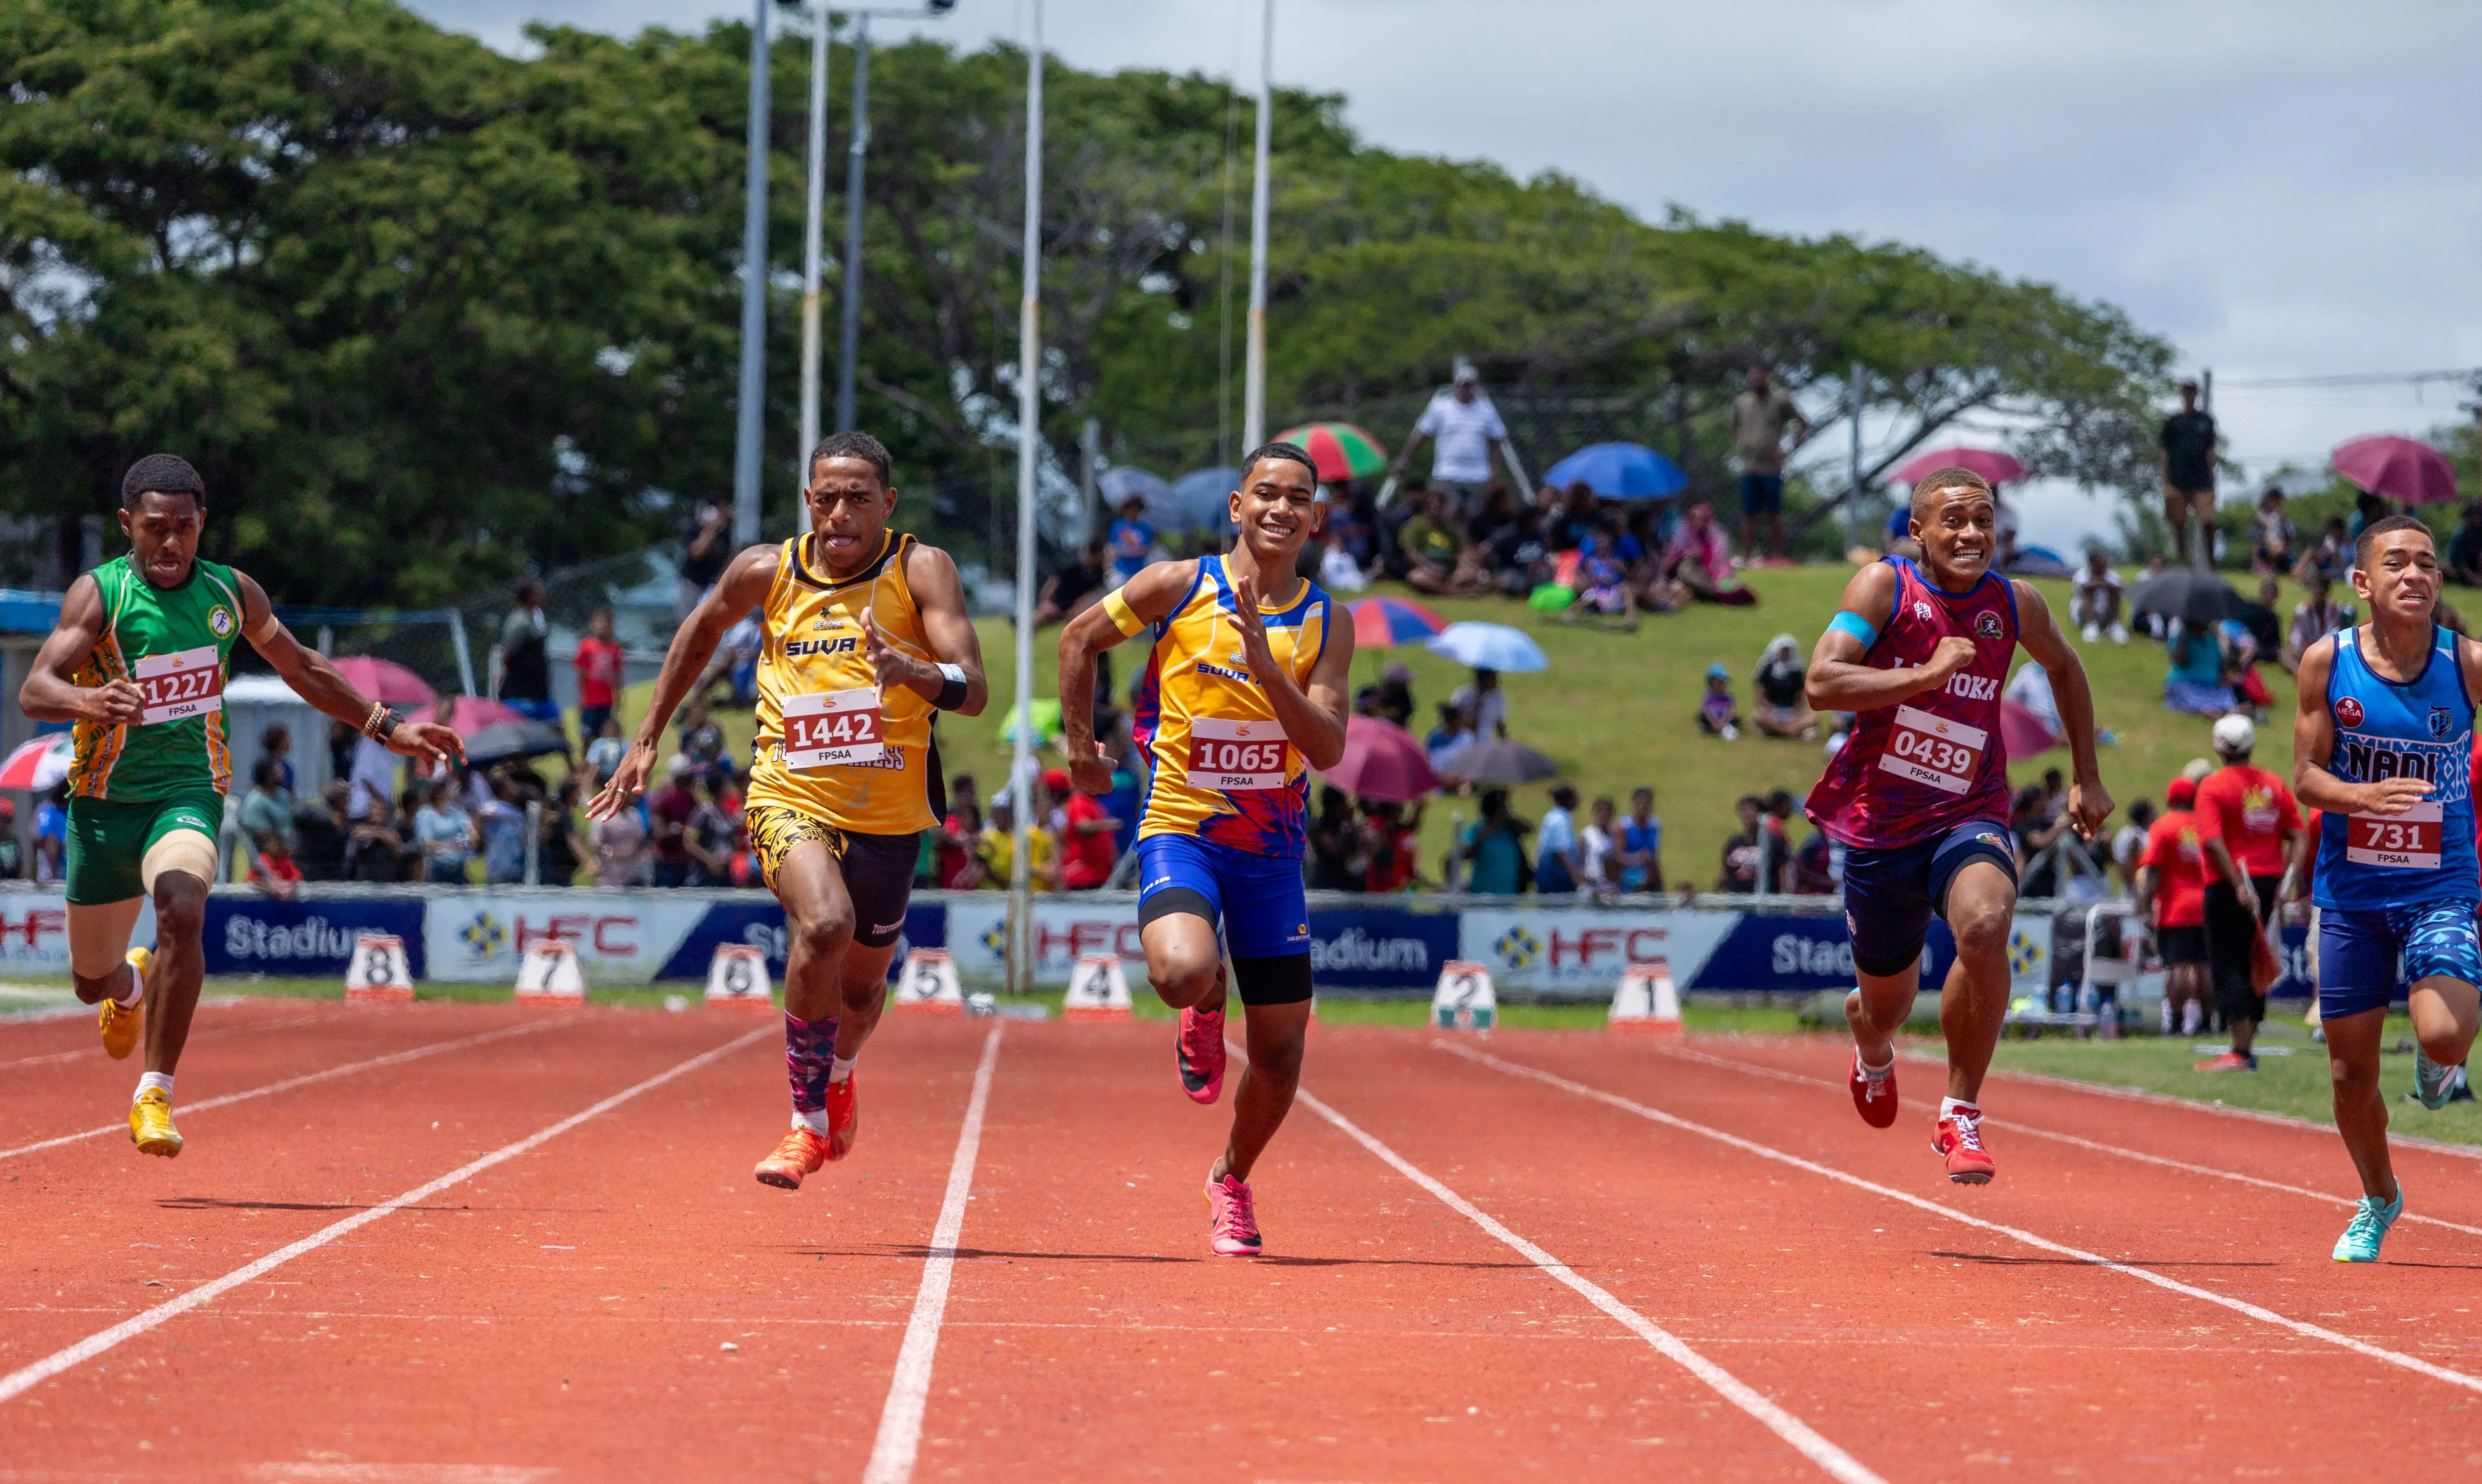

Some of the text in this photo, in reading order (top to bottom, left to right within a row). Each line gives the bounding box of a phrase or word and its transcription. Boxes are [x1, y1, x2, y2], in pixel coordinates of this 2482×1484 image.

[813, 620, 845, 629] BEYOND
[785, 637, 858, 656] SUVA
[146, 670, 214, 705] 1227
[1196, 662, 1250, 683] SUVA
[169, 704, 197, 716] FPSAA
[2337, 707, 2361, 717] MEGA
[793, 713, 875, 747] 1442
[818, 749, 852, 761] FPSAA
[1199, 742, 1280, 770] 1065
[1895, 730, 1971, 774] 0439
[2348, 742, 2437, 789] NADI
[1220, 776, 1254, 786] FPSAA
[1910, 766, 1941, 784] FPSAA
[2366, 823, 2423, 849] 731
[2377, 854, 2410, 864] FPSAA
[0, 910, 66, 947] HF
[225, 913, 388, 960] Stadiu
[513, 913, 638, 957] HFC
[1034, 919, 1148, 962] HFC
[366, 945, 394, 985] 8
[1311, 927, 1429, 972] adium
[1547, 927, 1668, 968] HFC
[541, 948, 563, 989] 7
[726, 956, 752, 993] 6
[916, 958, 941, 997] 5
[1082, 960, 1111, 998] 4
[1453, 973, 1478, 1012] 2
[1639, 975, 1656, 1016] 1
